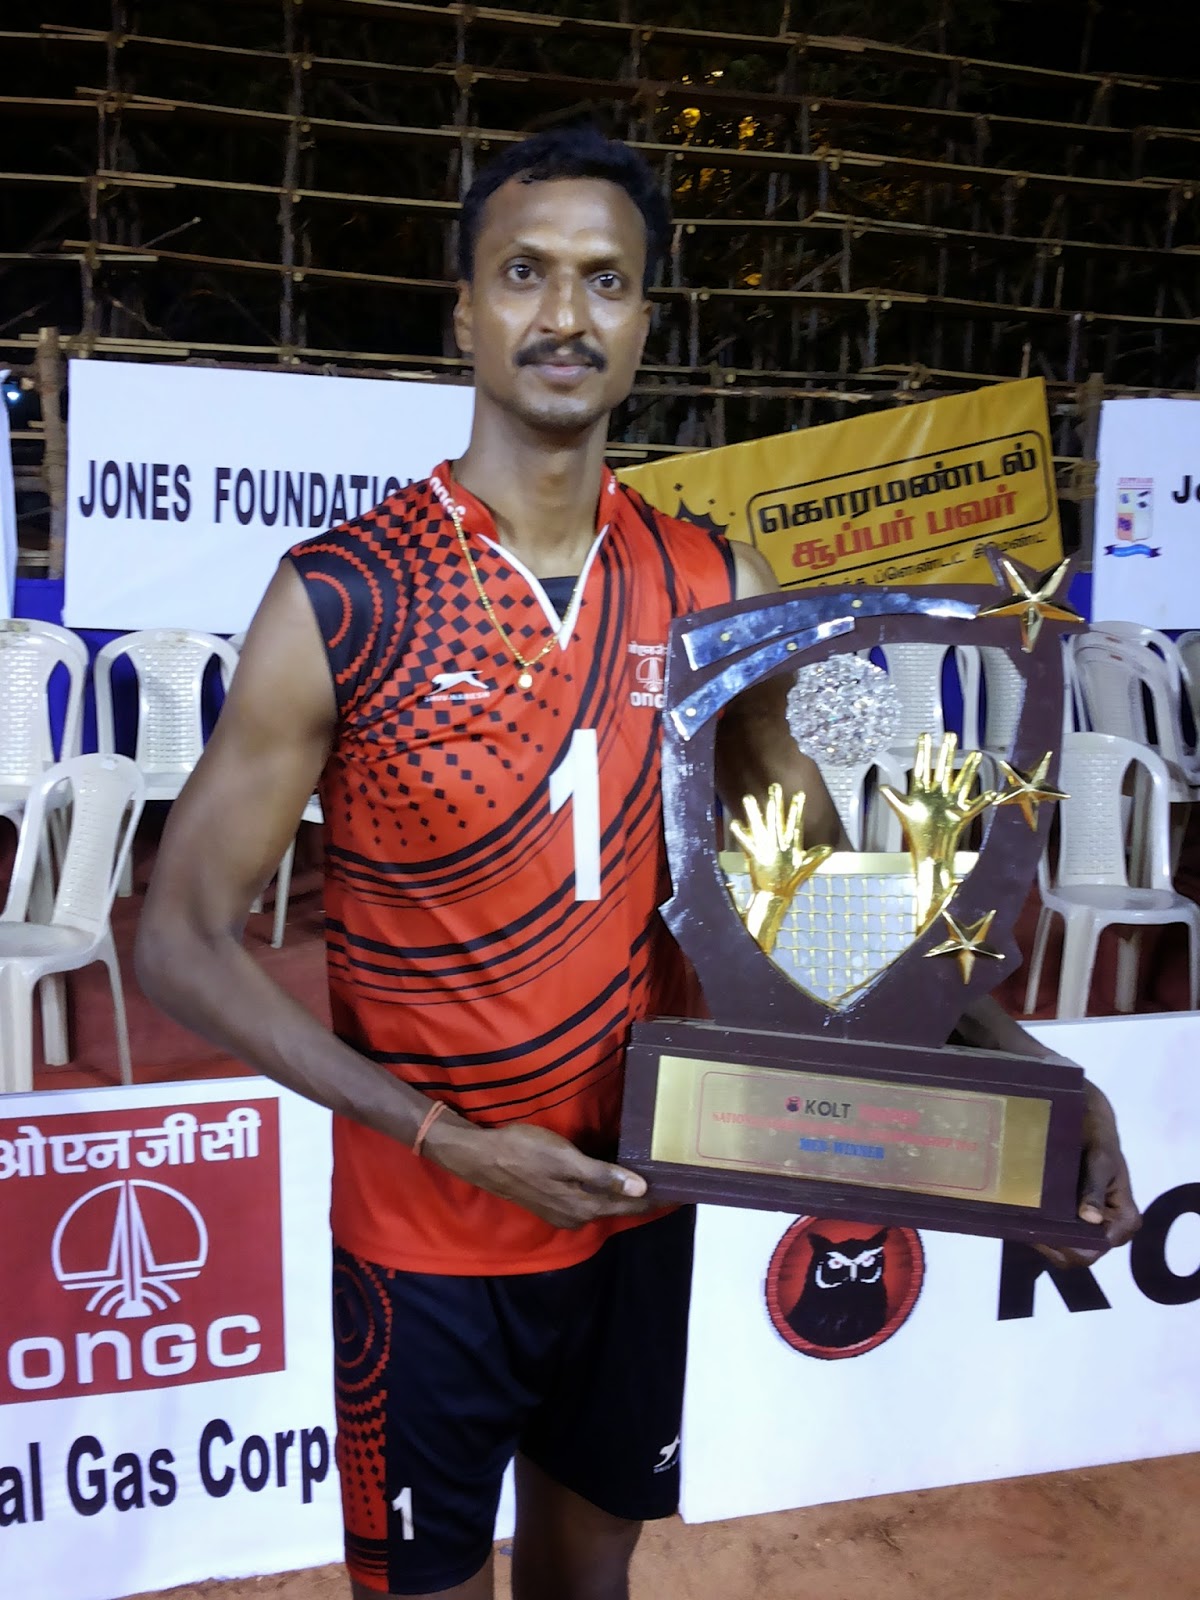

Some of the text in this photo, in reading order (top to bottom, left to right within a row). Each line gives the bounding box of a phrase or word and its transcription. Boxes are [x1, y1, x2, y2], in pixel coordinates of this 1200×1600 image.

[79, 460, 415, 528] JONES FOUNDATI
[758, 442, 1037, 534] கொரமண்டல்
[791, 483, 1019, 570] சூப்பர் பவர்
[549, 728, 601, 901] 1
[0, 1107, 261, 1179] ओएनजीसी
[804, 1099, 851, 1119] KOLT
[0, 1418, 330, 1527] al Gas Corp
[392, 1487, 414, 1540] 1
